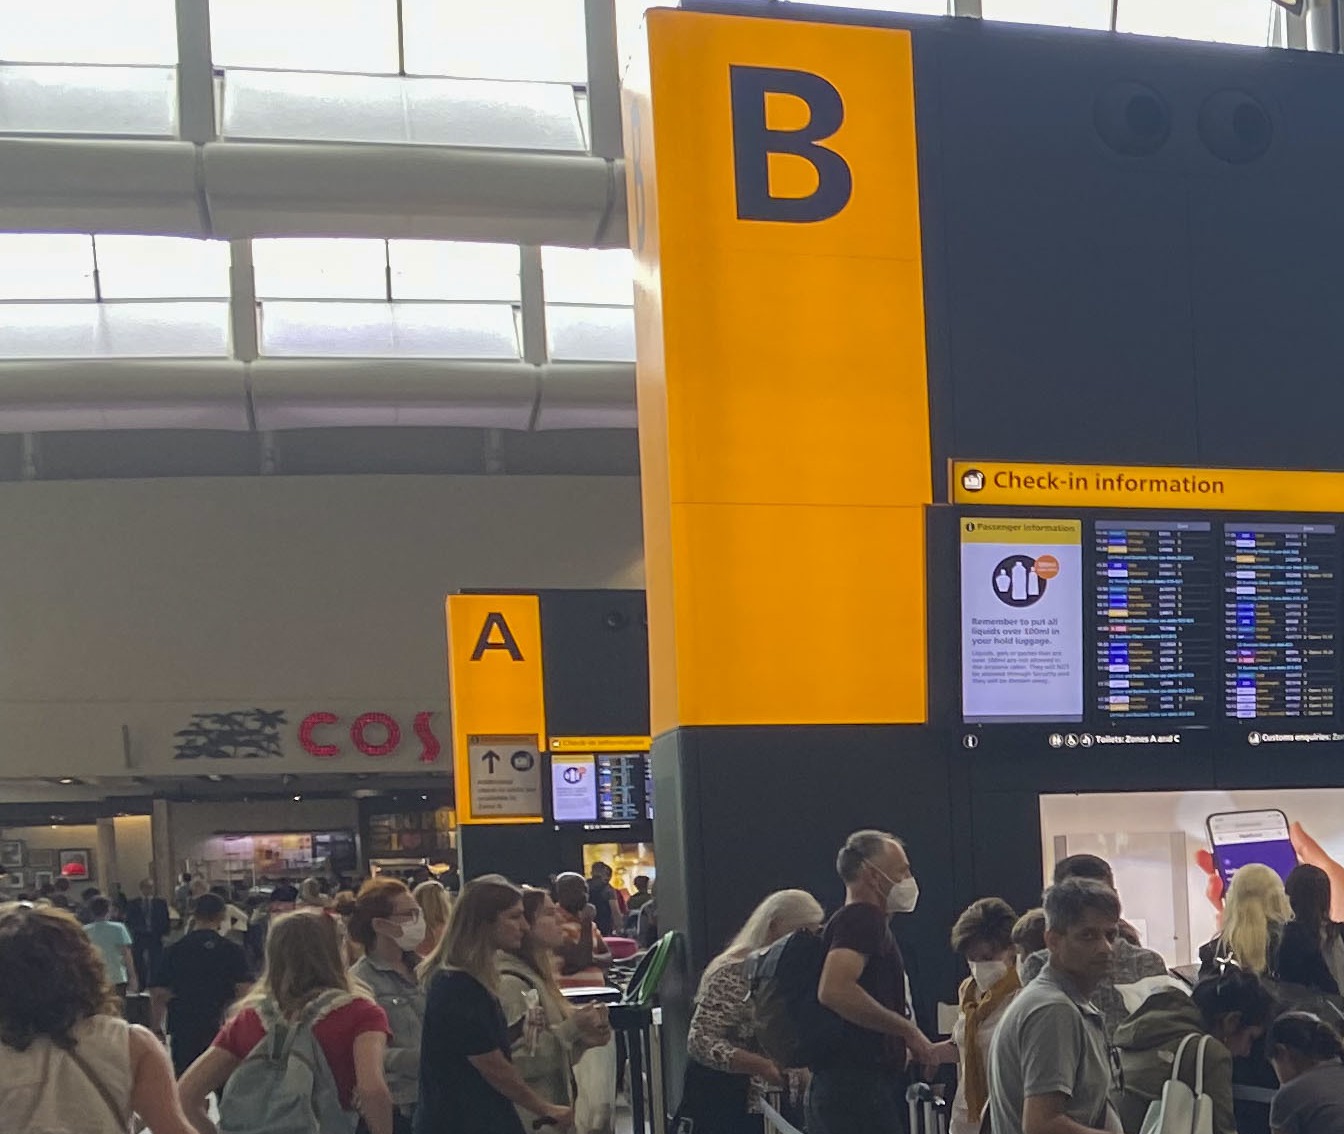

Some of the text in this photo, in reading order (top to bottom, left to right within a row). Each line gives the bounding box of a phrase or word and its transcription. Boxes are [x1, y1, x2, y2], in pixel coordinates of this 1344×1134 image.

[729, 64, 853, 224] B
[993, 471, 1225, 495] Check-in information
[977, 522, 1022, 533] Passenger
[971, 618, 1058, 627] Remember to put all
[470, 612, 525, 662] A
[971, 628, 1001, 637] liquids
[1024, 628, 1050, 636] 100ml
[1051, 628, 1060, 636] in
[971, 637, 1053, 647] your hold luggage.
[1095, 735, 1180, 744] Toilets: Zones A and C
[1261, 733, 1294, 742] Customs
[1294, 733, 1332, 743] enquiries:
